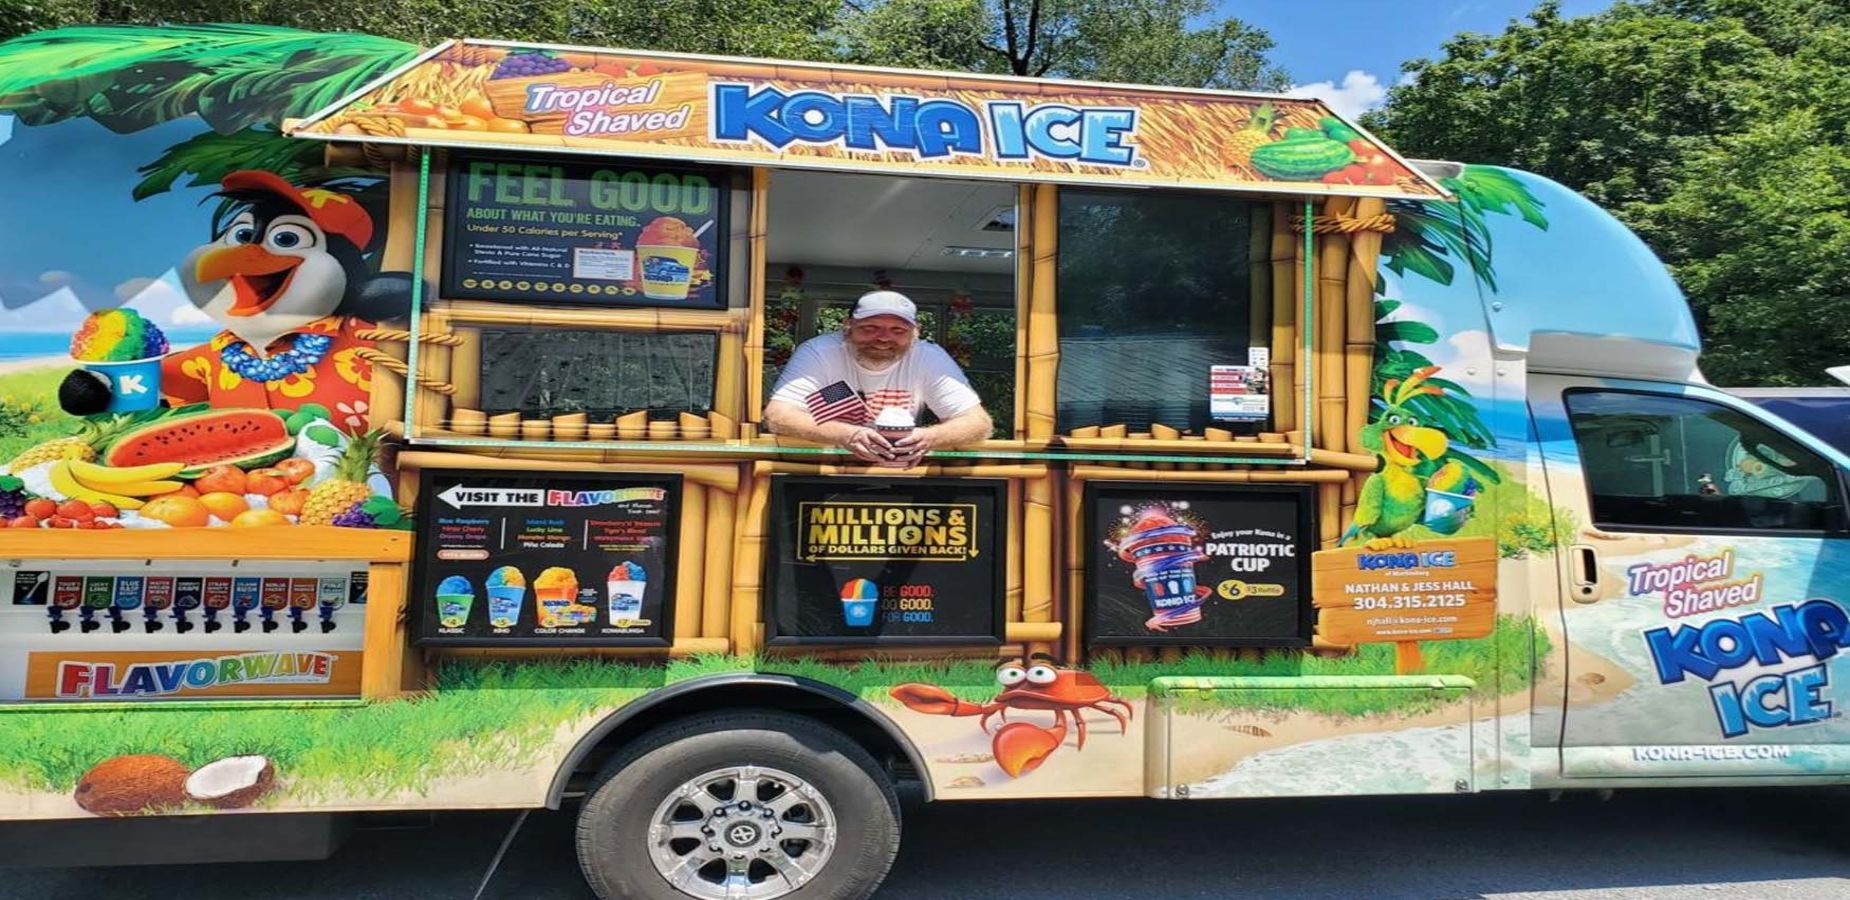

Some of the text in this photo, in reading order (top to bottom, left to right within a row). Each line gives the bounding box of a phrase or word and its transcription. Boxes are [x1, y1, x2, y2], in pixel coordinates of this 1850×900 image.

[527, 79, 662, 113] Tropical
[567, 104, 692, 135] Shaved
[714, 83, 1139, 165] KONA ICE
[467, 161, 712, 215] FEEL GOOD
[466, 207, 641, 228] ABOUT WHAT YOU'RE EATING.
[467, 223, 499, 233] Under
[501, 225, 516, 234] 50
[518, 226, 559, 237] Calories
[561, 230, 578, 239] per
[119, 374, 148, 396] K
[455, 491, 503, 503] VISIT
[507, 492, 539, 503] THE
[810, 507, 966, 526] MILLIONS &
[808, 525, 968, 546] MILLIONS
[1235, 529, 1254, 537] your
[809, 545, 967, 555] OF DOLLARS GIVEN BACK!
[1205, 542, 1296, 558] PATRIOTIC
[1231, 557, 1271, 572] CUP
[1357, 551, 1456, 570] KONA ICE
[1629, 551, 1731, 593] Tropical
[900, 584, 934, 597] GOOD.
[1222, 583, 1241, 596] $6
[1345, 580, 1473, 594] NATHAN & JESS HALL
[900, 598, 934, 611] GOOD.
[1353, 594, 1467, 610] 304.315.2125
[1665, 576, 1759, 618] Shaved
[903, 611, 934, 623] GOOD.
[1644, 599, 1850, 685] KONA
[60, 652, 331, 697] FLAVORWAVE
[1708, 663, 1832, 739] ICE
[1633, 745, 1792, 761] KONA-ICE.COM
